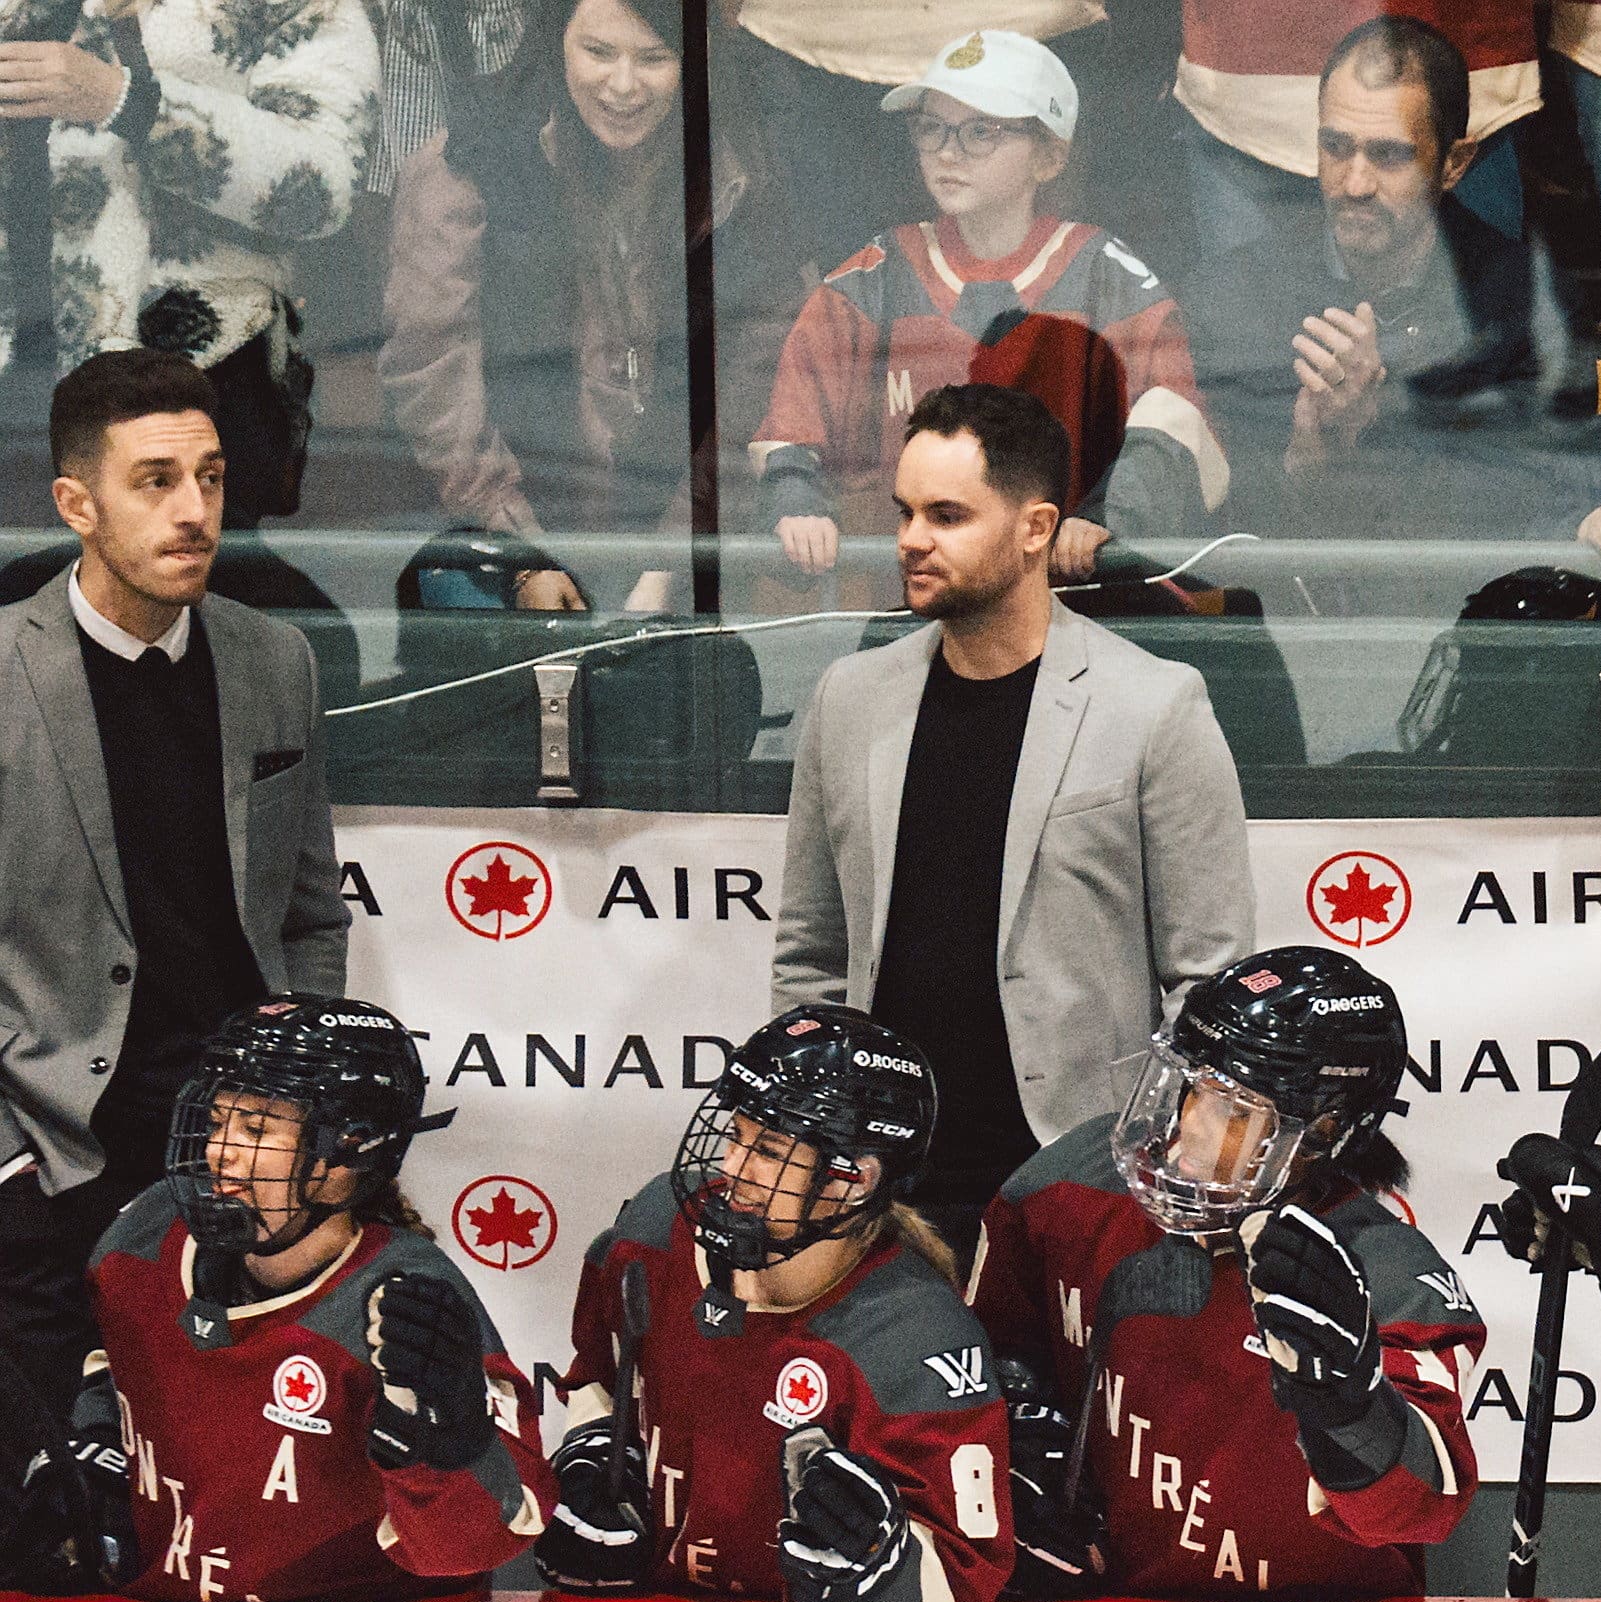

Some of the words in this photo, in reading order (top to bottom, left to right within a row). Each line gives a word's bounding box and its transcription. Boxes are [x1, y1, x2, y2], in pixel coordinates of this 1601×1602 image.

[597, 866, 773, 922] AIR
[337, 1013, 395, 1030] ROGERS
[1329, 995, 1385, 1012] ROGERS
[418, 1030, 737, 1091] ANAD
[729, 1060, 772, 1093] CCM
[872, 1055, 923, 1078] ROGERS
[865, 1119, 916, 1139] CCM
[1058, 1278, 1269, 1592] MNTRÉA
[261, 1433, 299, 1503] A
[950, 1443, 999, 1539] 8
